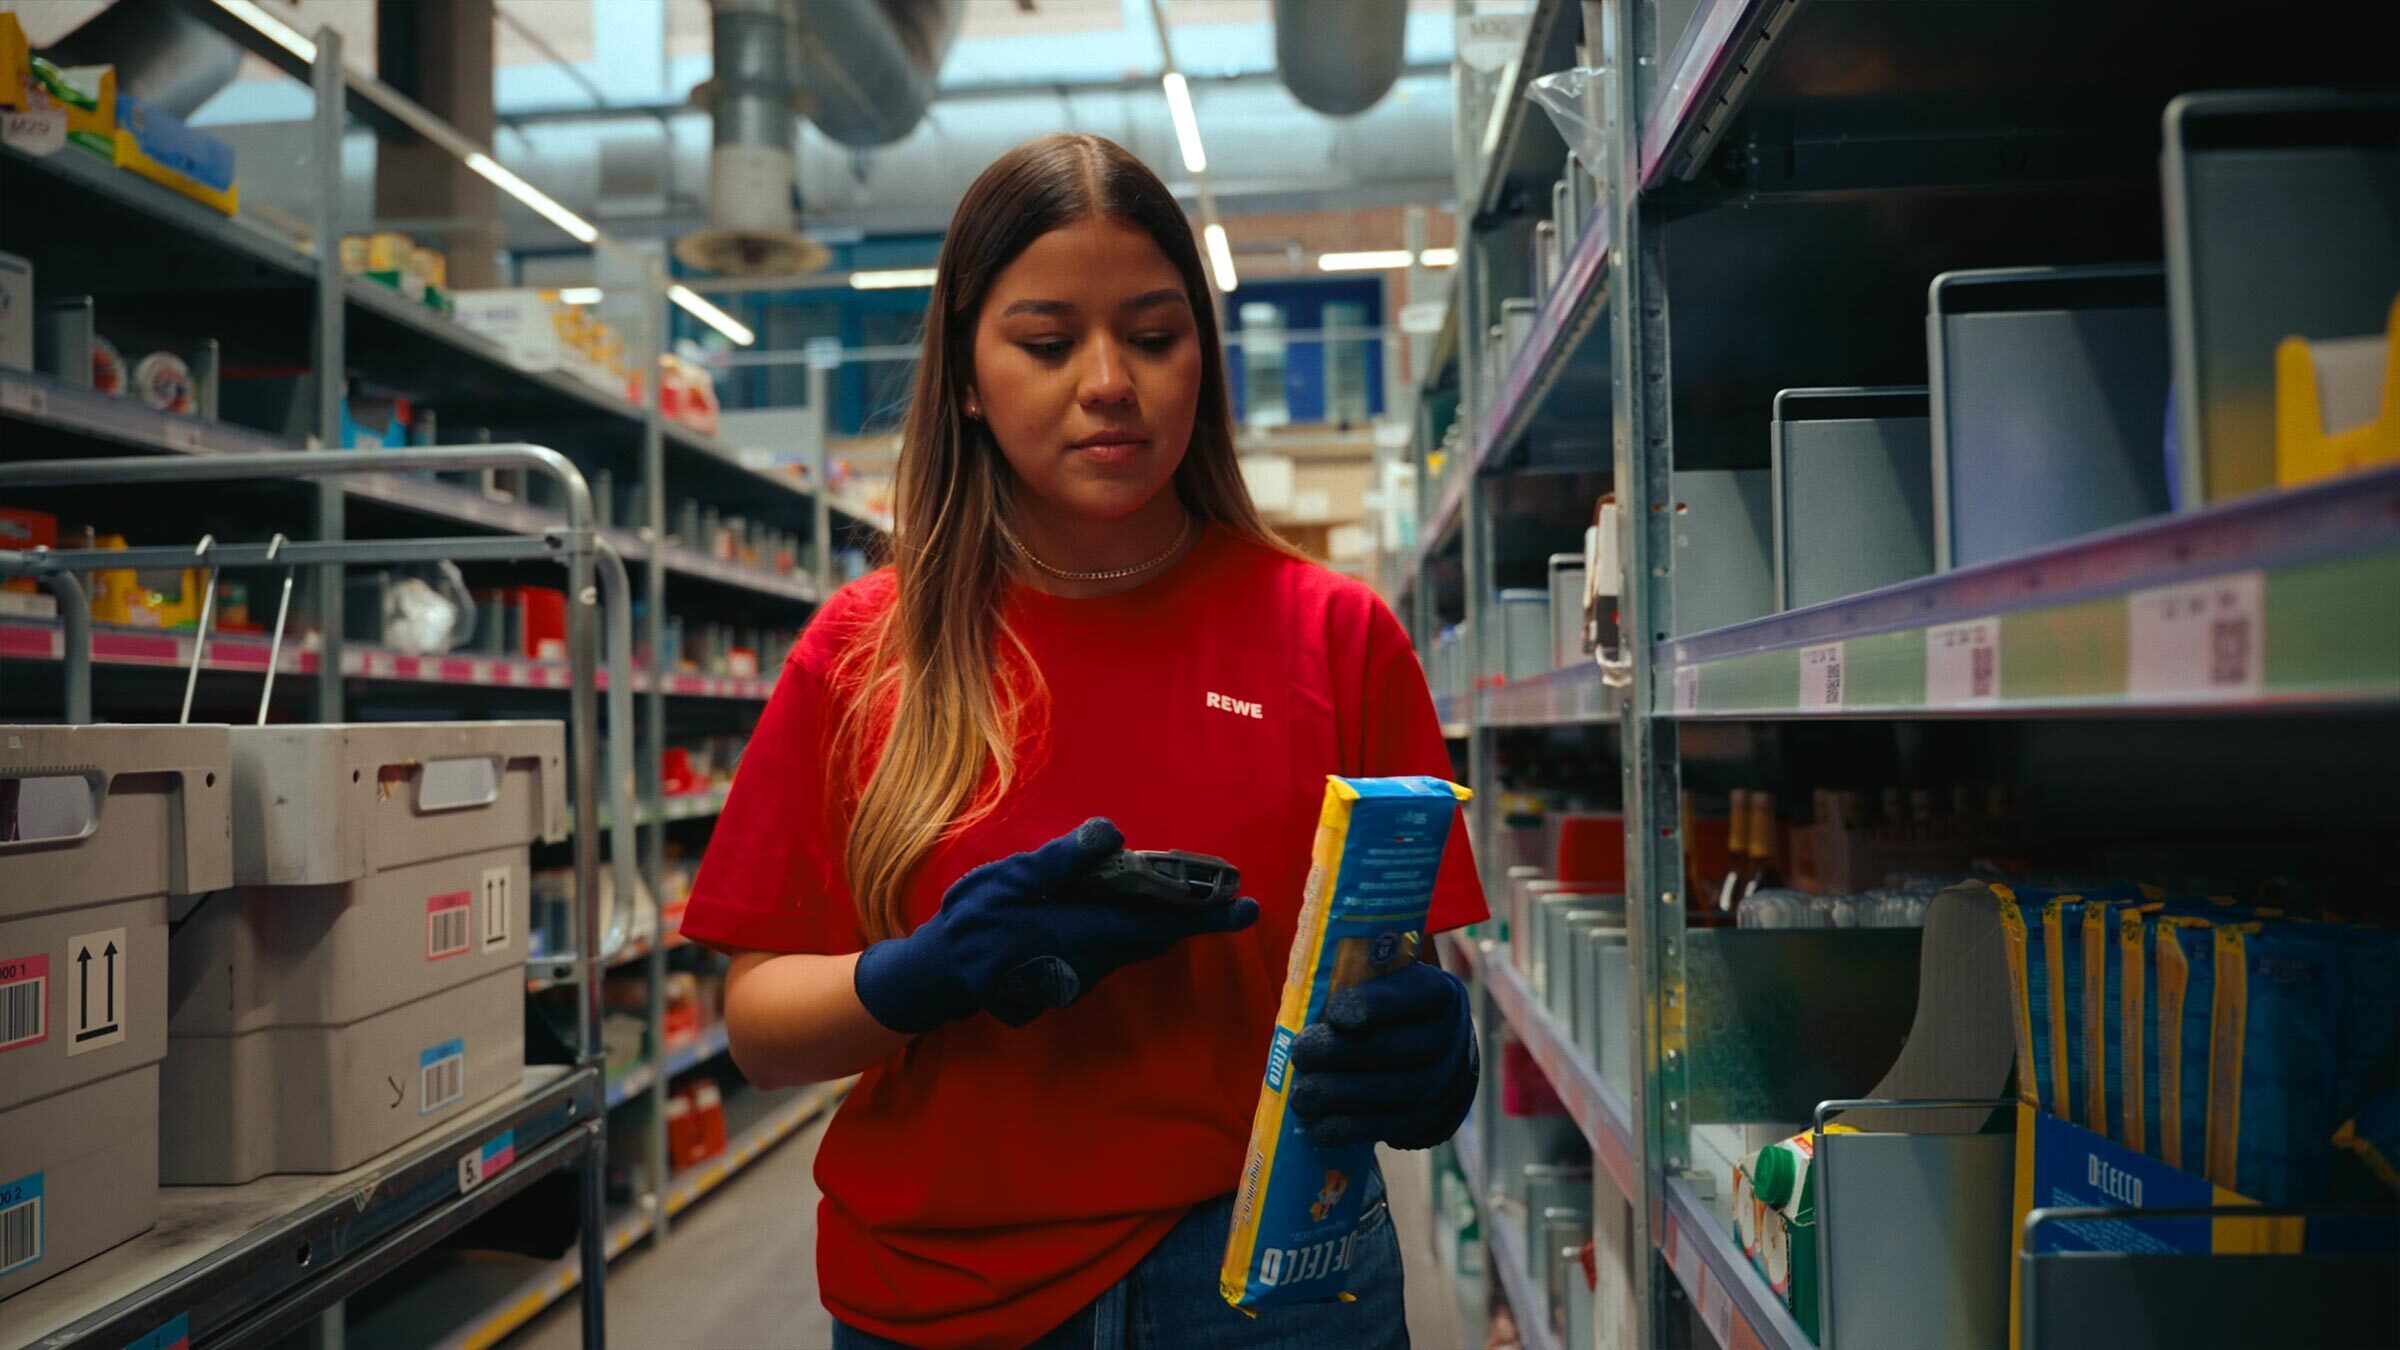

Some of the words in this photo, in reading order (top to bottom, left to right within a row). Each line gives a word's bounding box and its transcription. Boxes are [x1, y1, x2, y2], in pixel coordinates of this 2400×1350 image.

[1206, 691, 1264, 719] REWE
[0, 965, 17, 980] 00
[20, 962, 26, 977] 1
[15, 1185, 22, 1201] 2
[1258, 1240, 1335, 1287] CECCO
